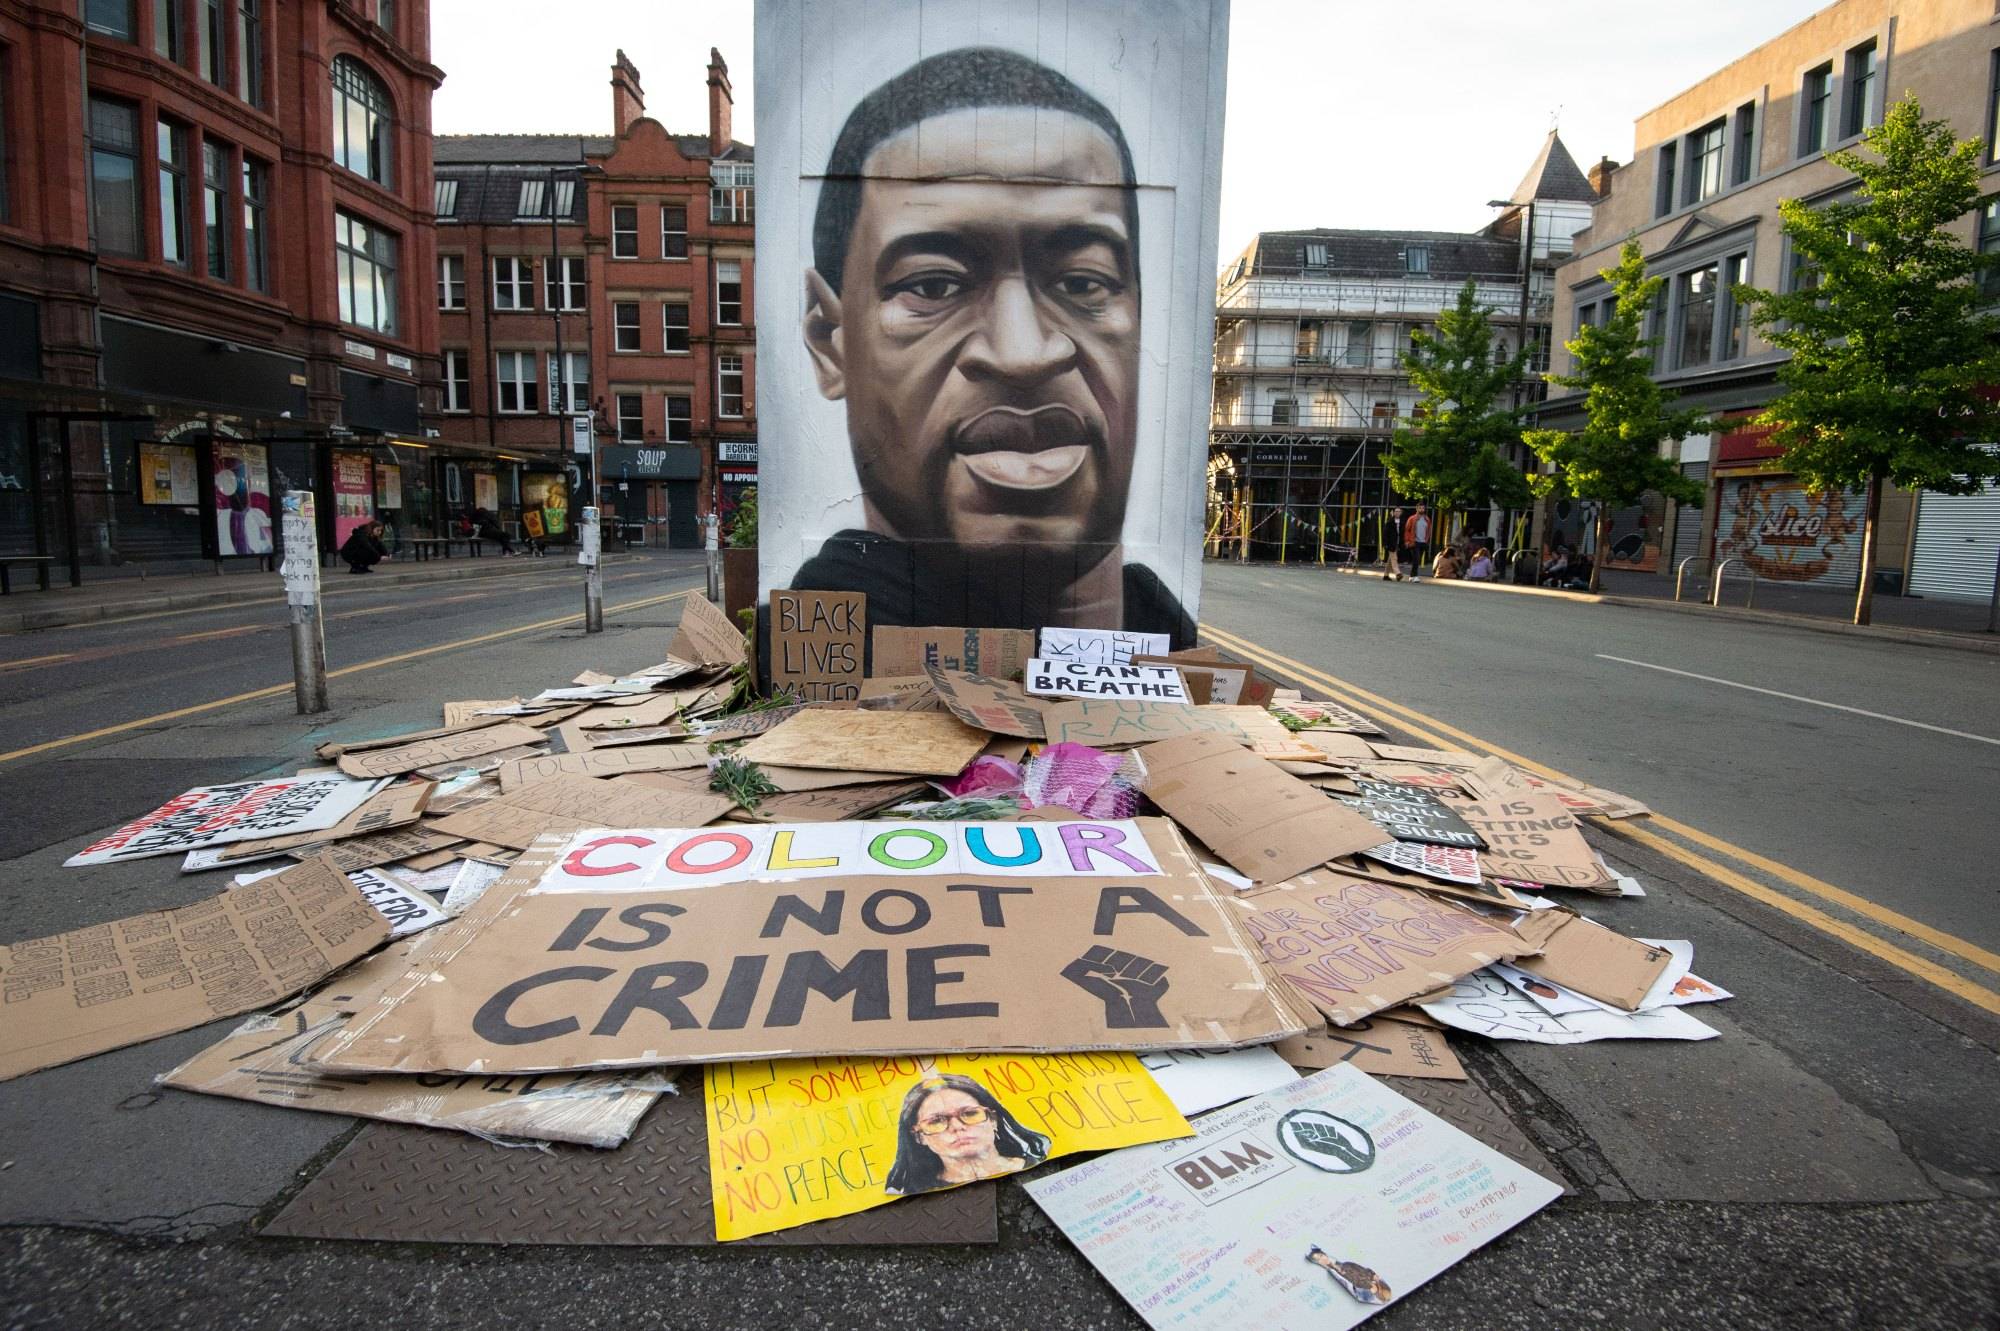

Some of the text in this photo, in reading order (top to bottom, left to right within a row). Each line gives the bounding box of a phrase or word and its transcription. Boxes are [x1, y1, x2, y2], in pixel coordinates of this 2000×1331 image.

[637, 450, 666, 465] SOUP
[732, 444, 758, 453] CORNE
[723, 473, 758, 481] NO APPOIN
[780, 596, 862, 635] BLACK
[784, 640, 857, 675] LIVES
[1043, 661, 1173, 679] I CAN'T
[1035, 675, 1183, 698] BREATHE
[517, 750, 651, 784] POLICE
[1373, 810, 1425, 824] NOT
[1472, 815, 1574, 832] ETTING
[1501, 801, 1534, 816] IS
[563, 824, 1165, 876] COLOUR
[1395, 824, 1477, 844] SILENT
[1493, 833, 1550, 846] IT'S
[354, 873, 429, 928] TICE FOR
[1315, 879, 1406, 918] SKIN
[546, 885, 1209, 952] IS NOT A
[1262, 907, 1396, 964] COLOUR
[1281, 943, 1392, 1005] NOT
[471, 944, 1000, 1045] CRIME
[714, 1085, 773, 1132] BUT
[789, 1055, 945, 1109] SOMEBOD
[985, 1060, 1033, 1100] NO
[1034, 1050, 1131, 1086] RACIST
[1028, 1082, 1162, 1138] POLICE
[719, 1093, 904, 1171] NO JUSTICE
[724, 1145, 885, 1222] NO PEACE
[1174, 1140, 1275, 1190] BLM
